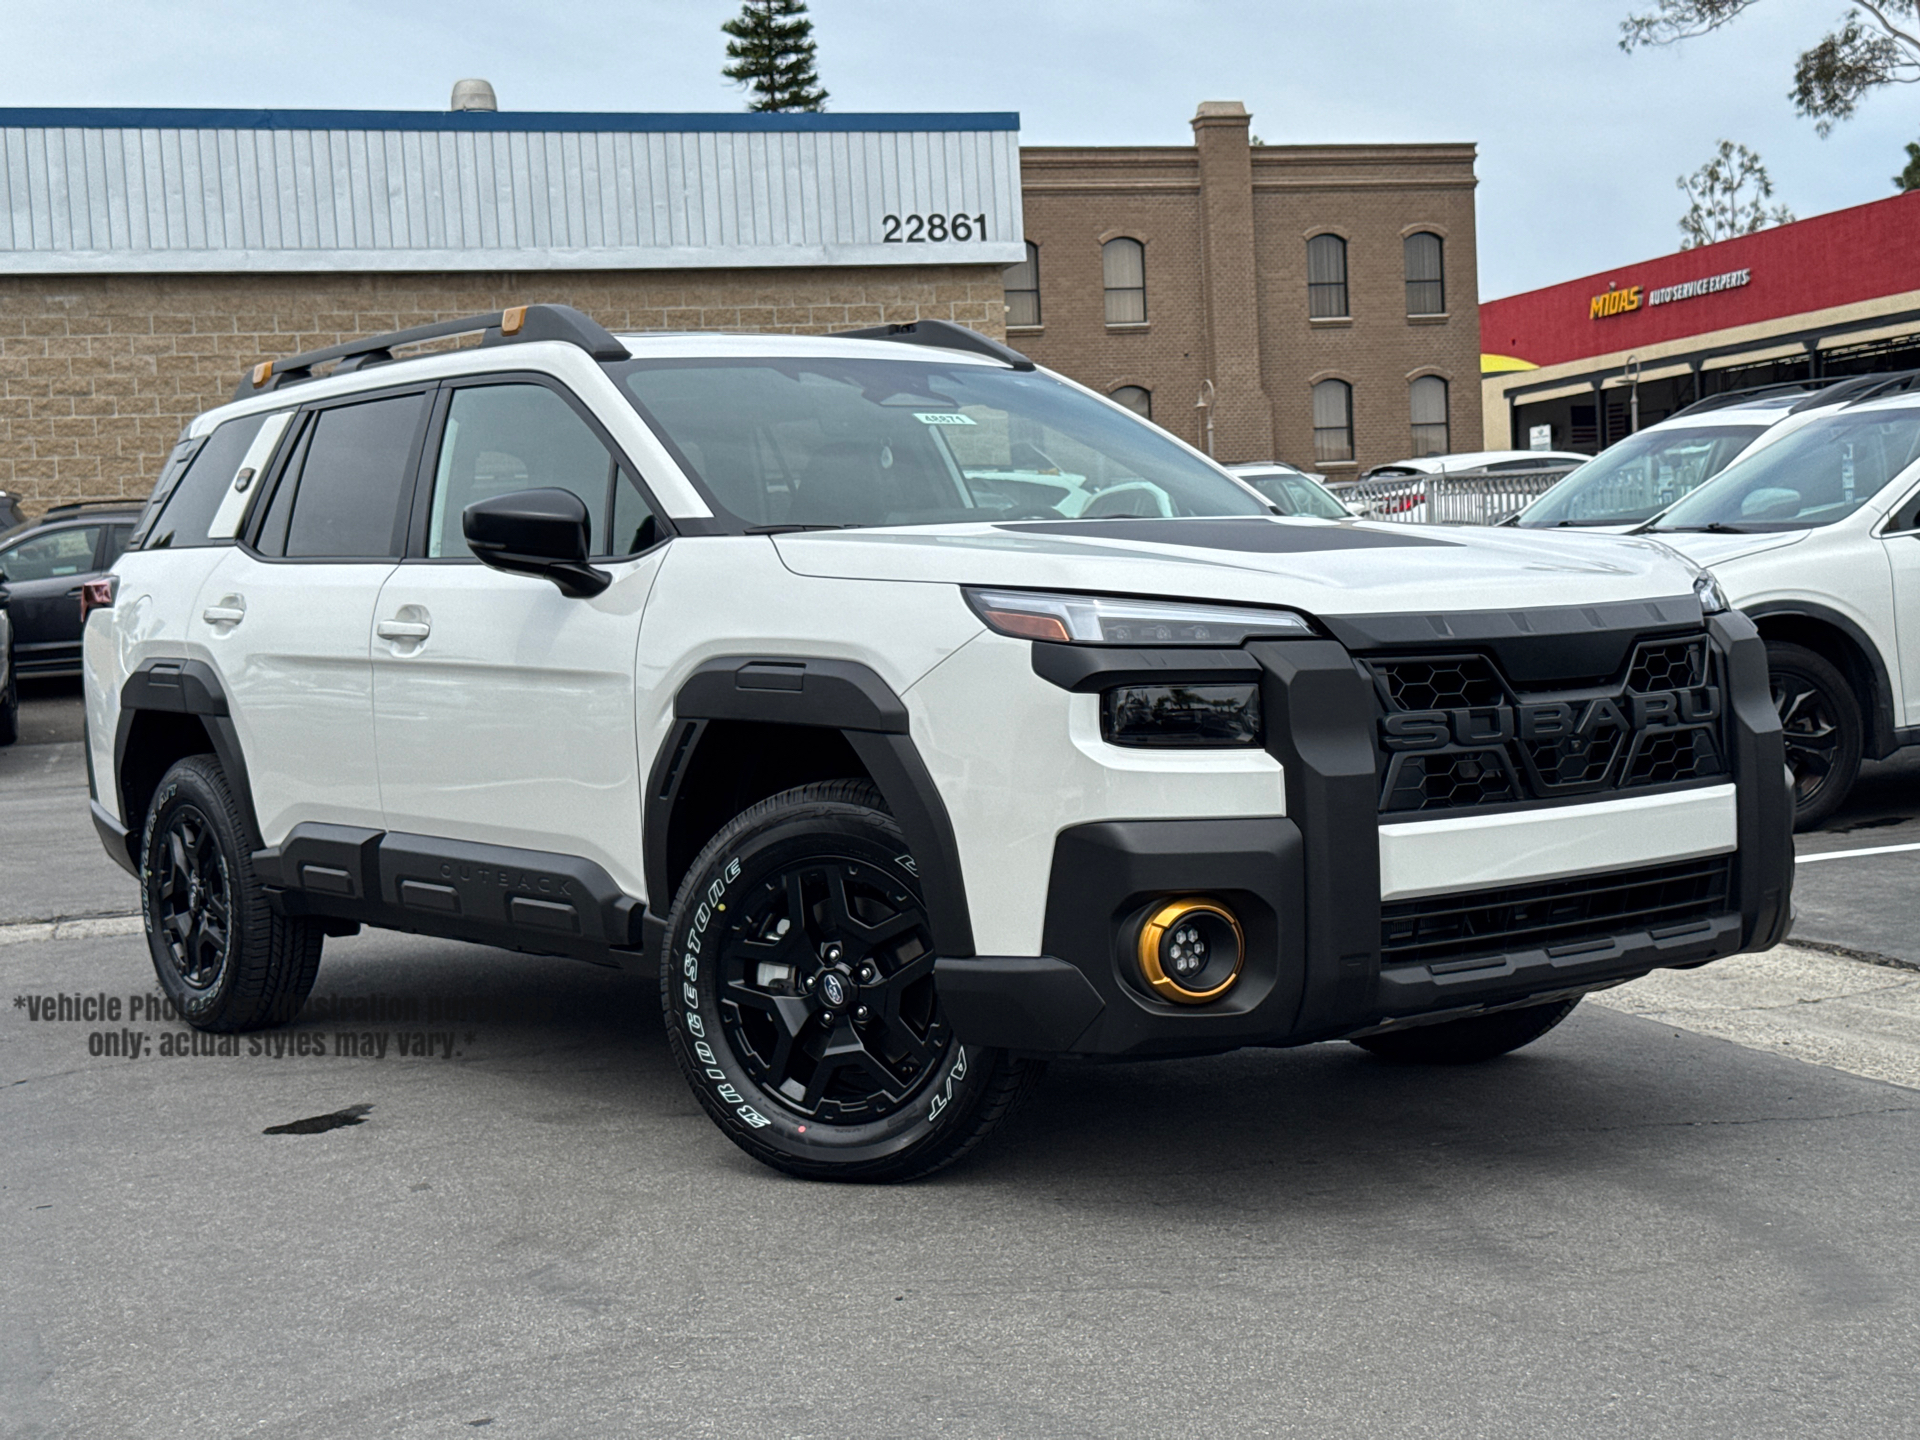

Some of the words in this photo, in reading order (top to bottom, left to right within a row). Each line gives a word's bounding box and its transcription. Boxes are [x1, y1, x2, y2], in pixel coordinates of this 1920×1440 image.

[882, 213, 987, 243] 22861
[1589, 285, 1643, 319] MIDAS
[1649, 288, 1671, 306] AUTO
[1671, 276, 1709, 302] SERVICE
[1709, 268, 1750, 293] EXPERTS
[1381, 685, 1721, 750] SUBARU
[440, 862, 572, 896] OUTBACK
[684, 857, 772, 1129] BRIDGESTONE
[928, 1045, 968, 1122] A/T
